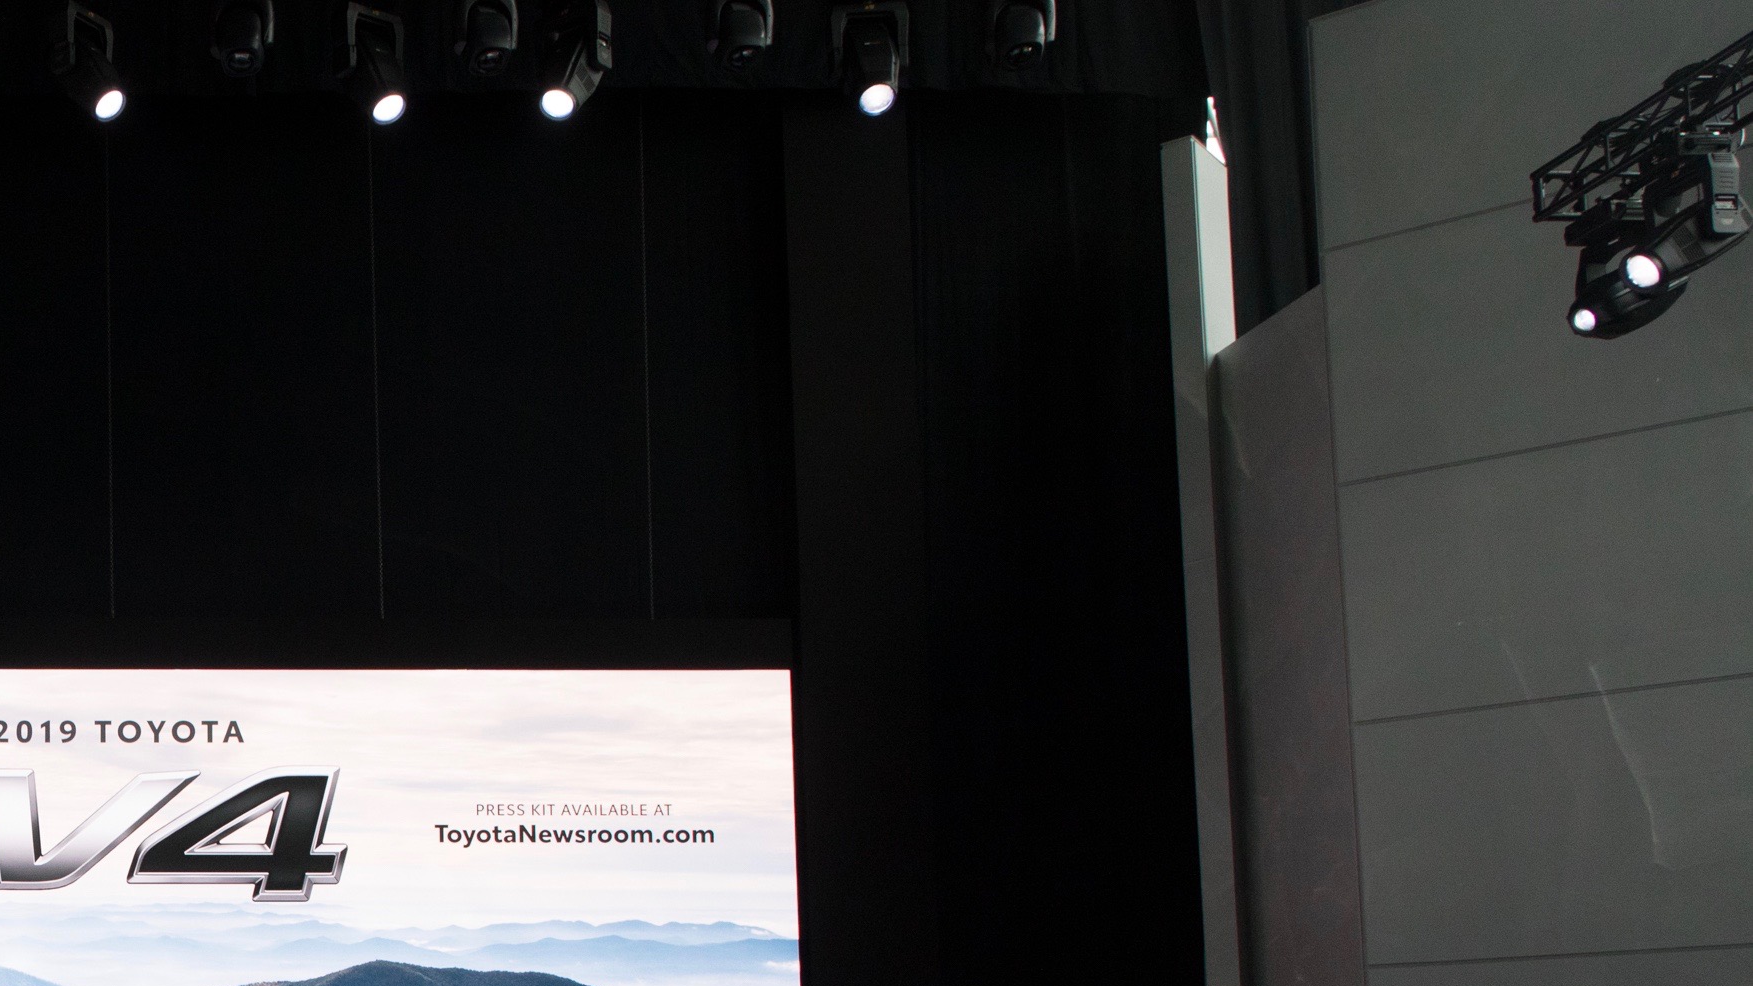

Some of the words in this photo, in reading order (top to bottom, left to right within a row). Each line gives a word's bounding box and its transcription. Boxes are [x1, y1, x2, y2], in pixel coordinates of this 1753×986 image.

[95, 720, 245, 743] TOYOTA
[476, 803, 525, 816] PRESS
[532, 803, 555, 816] KIT
[561, 803, 648, 816] AVAILABLE
[653, 803, 672, 816] AT
[435, 824, 715, 848] ToyotaNewsroom.com
